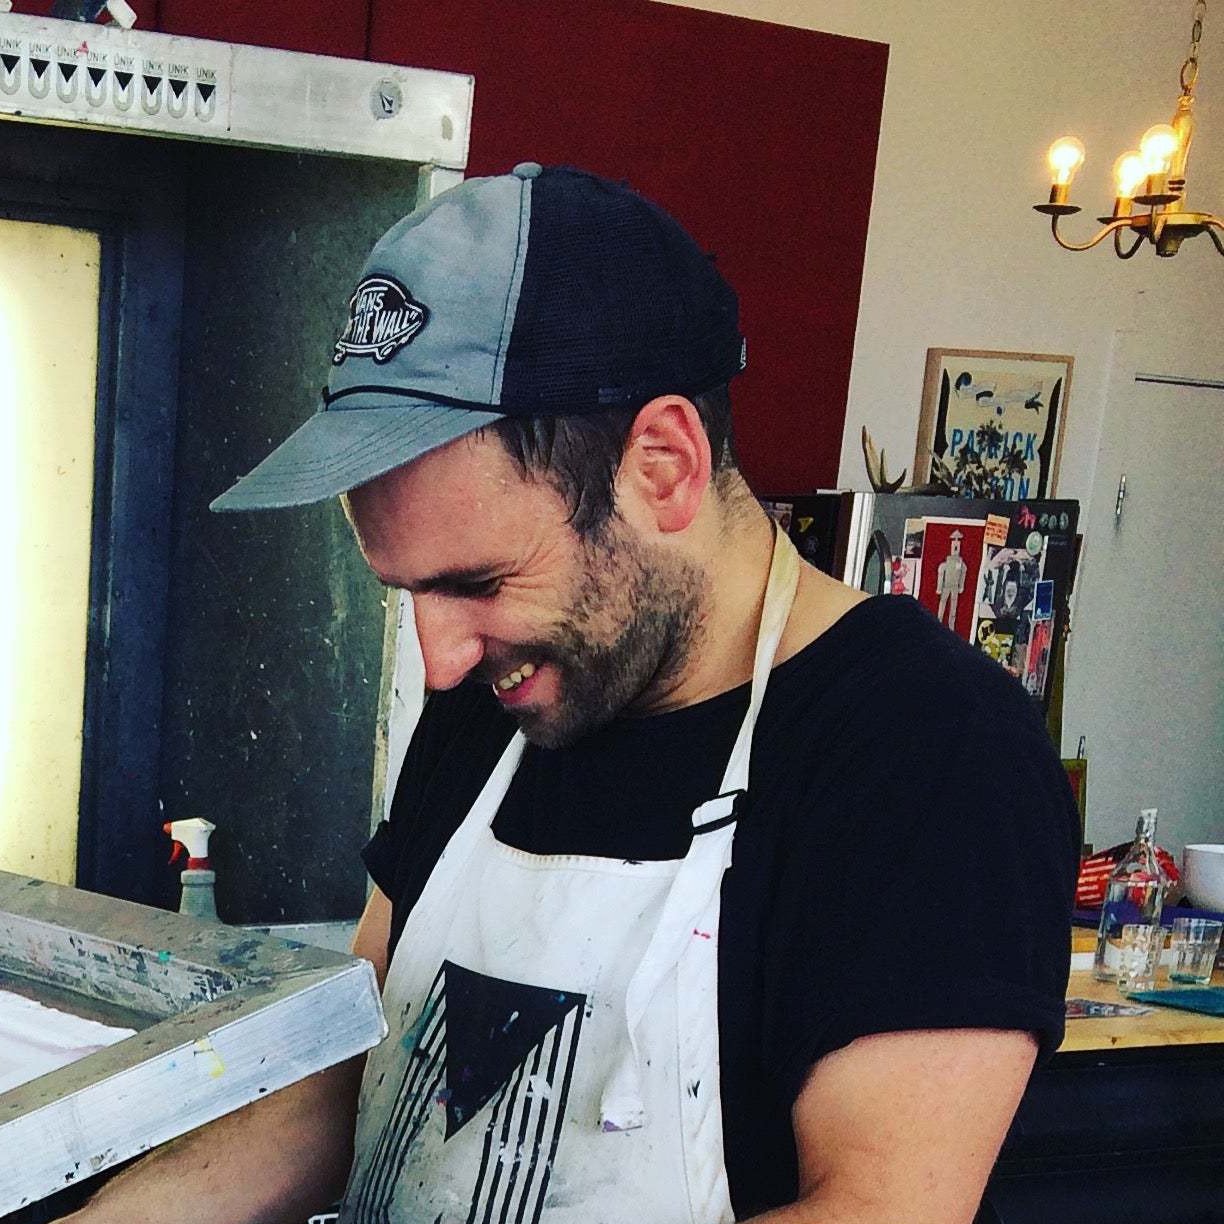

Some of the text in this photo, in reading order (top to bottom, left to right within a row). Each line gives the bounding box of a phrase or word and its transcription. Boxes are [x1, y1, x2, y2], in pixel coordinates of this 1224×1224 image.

[0, 37, 22, 49] UNIK
[29, 42, 51, 54] UNIK
[57, 45, 78, 59] UNIK
[87, 51, 108, 63] UNIK
[114, 54, 135, 67] UNIK
[142, 59, 163, 71] UNIK
[168, 63, 189, 75] UNIK
[196, 66, 217, 80] UNIK
[352, 312, 374, 344] THE
[951, 428, 1037, 461] PARICK
